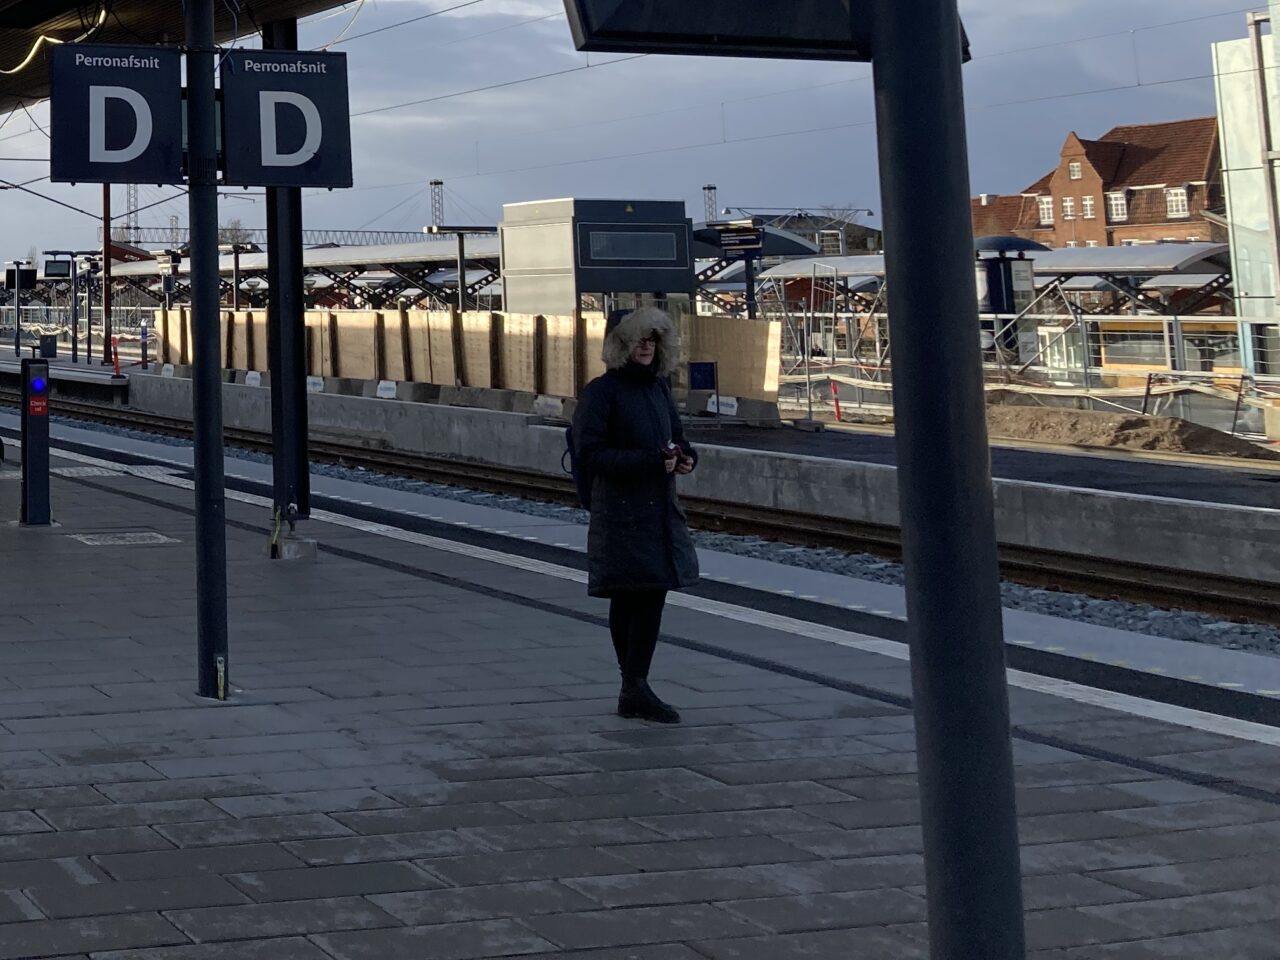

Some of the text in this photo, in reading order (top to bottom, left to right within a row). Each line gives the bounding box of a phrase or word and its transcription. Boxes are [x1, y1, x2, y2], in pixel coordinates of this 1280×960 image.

[75, 53, 160, 69] Perronafsnit
[244, 59, 327, 74] Perronafsnit
[89, 85, 153, 163] D
[259, 91, 322, 167] D
